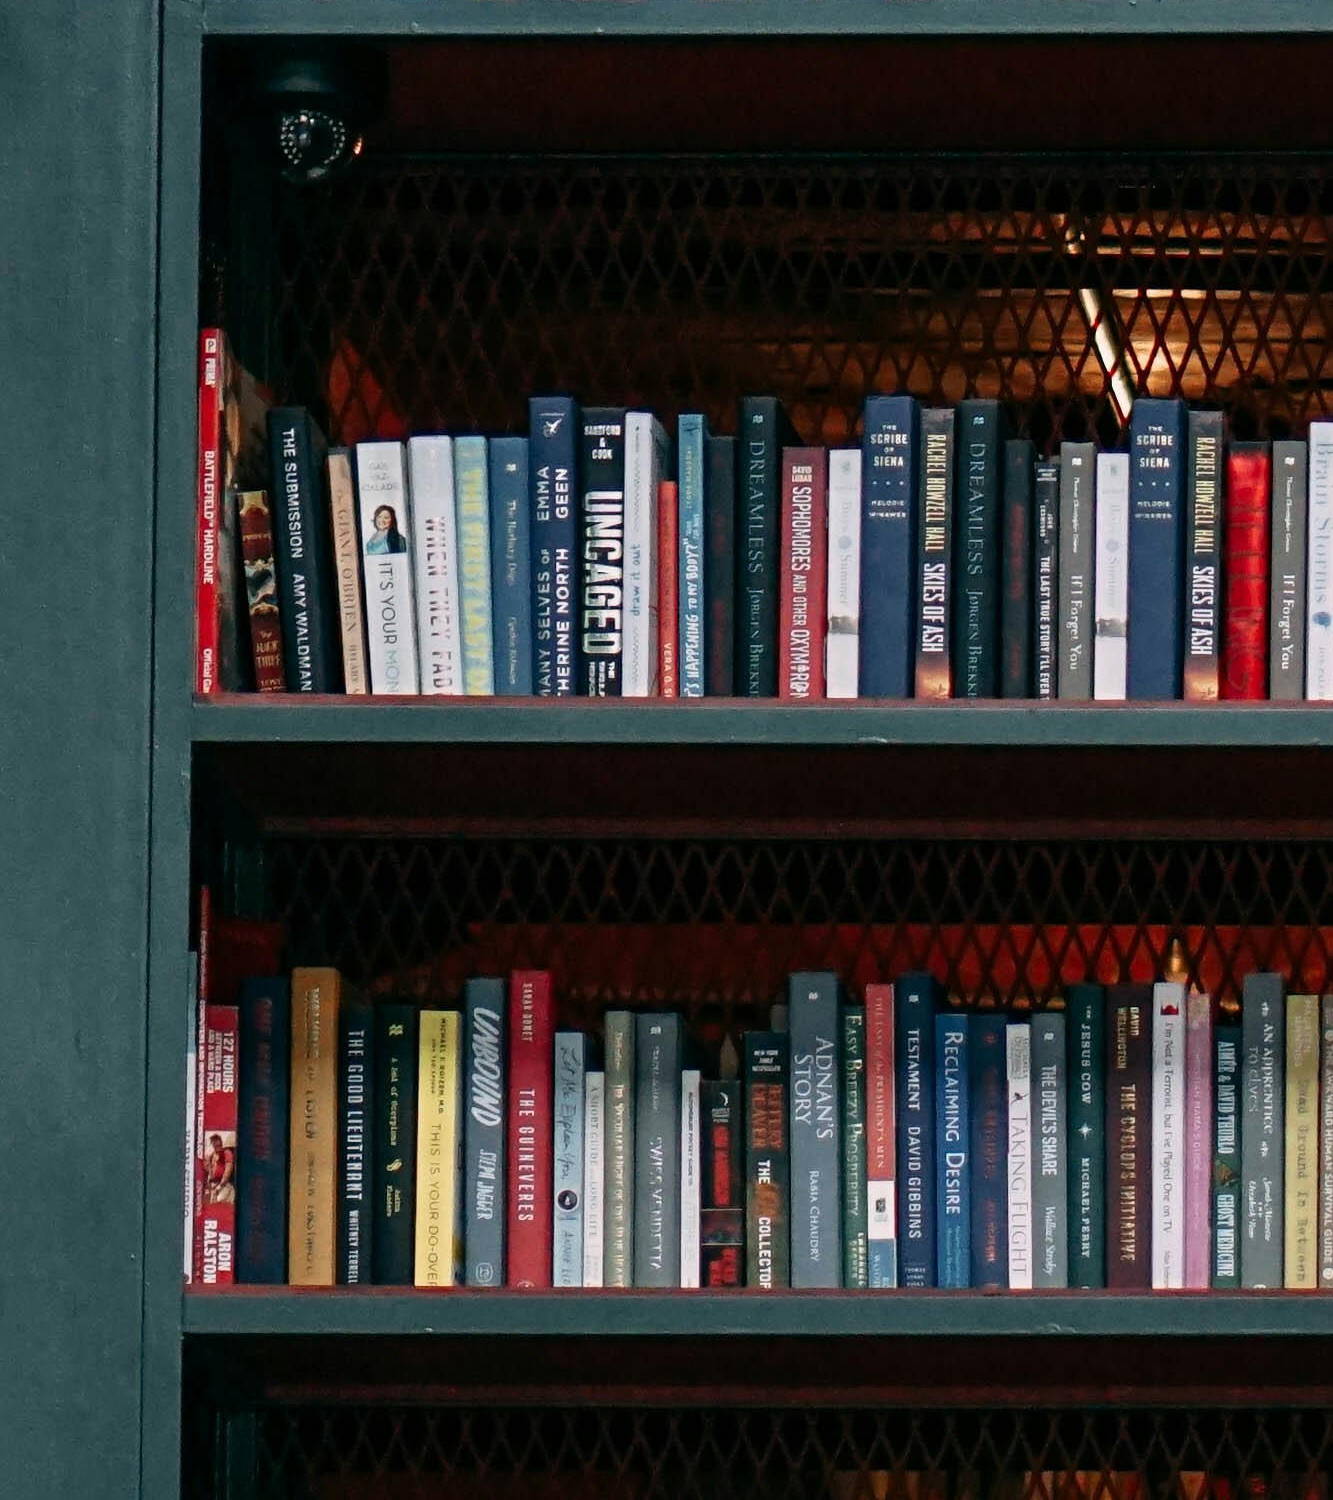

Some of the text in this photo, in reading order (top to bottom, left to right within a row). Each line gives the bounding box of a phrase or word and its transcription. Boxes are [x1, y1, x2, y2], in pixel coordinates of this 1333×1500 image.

[282, 429, 303, 558] THE SUBMISSION
[203, 530, 214, 584] HARDLINE
[582, 490, 622, 653] UNCAGED
[922, 563, 946, 652] SKIES OF ASH
[292, 574, 312, 691] AMY WALDMAN
[346, 1030, 364, 1200] THE GOOD LIEUTENANT
[471, 1007, 501, 1125] UNBOUND
[794, 1054, 811, 1124] STORY
[907, 1029, 920, 1110] TESTAMENT
[944, 1032, 964, 1214] RECLAIMING DESIRE
[519, 1089, 535, 1220] THE GUINEVERES
[908, 1126, 922, 1238] DAVID GIBBINS
[203, 1220, 218, 1283] RALSTON
[218, 1232, 231, 1270] ARON
